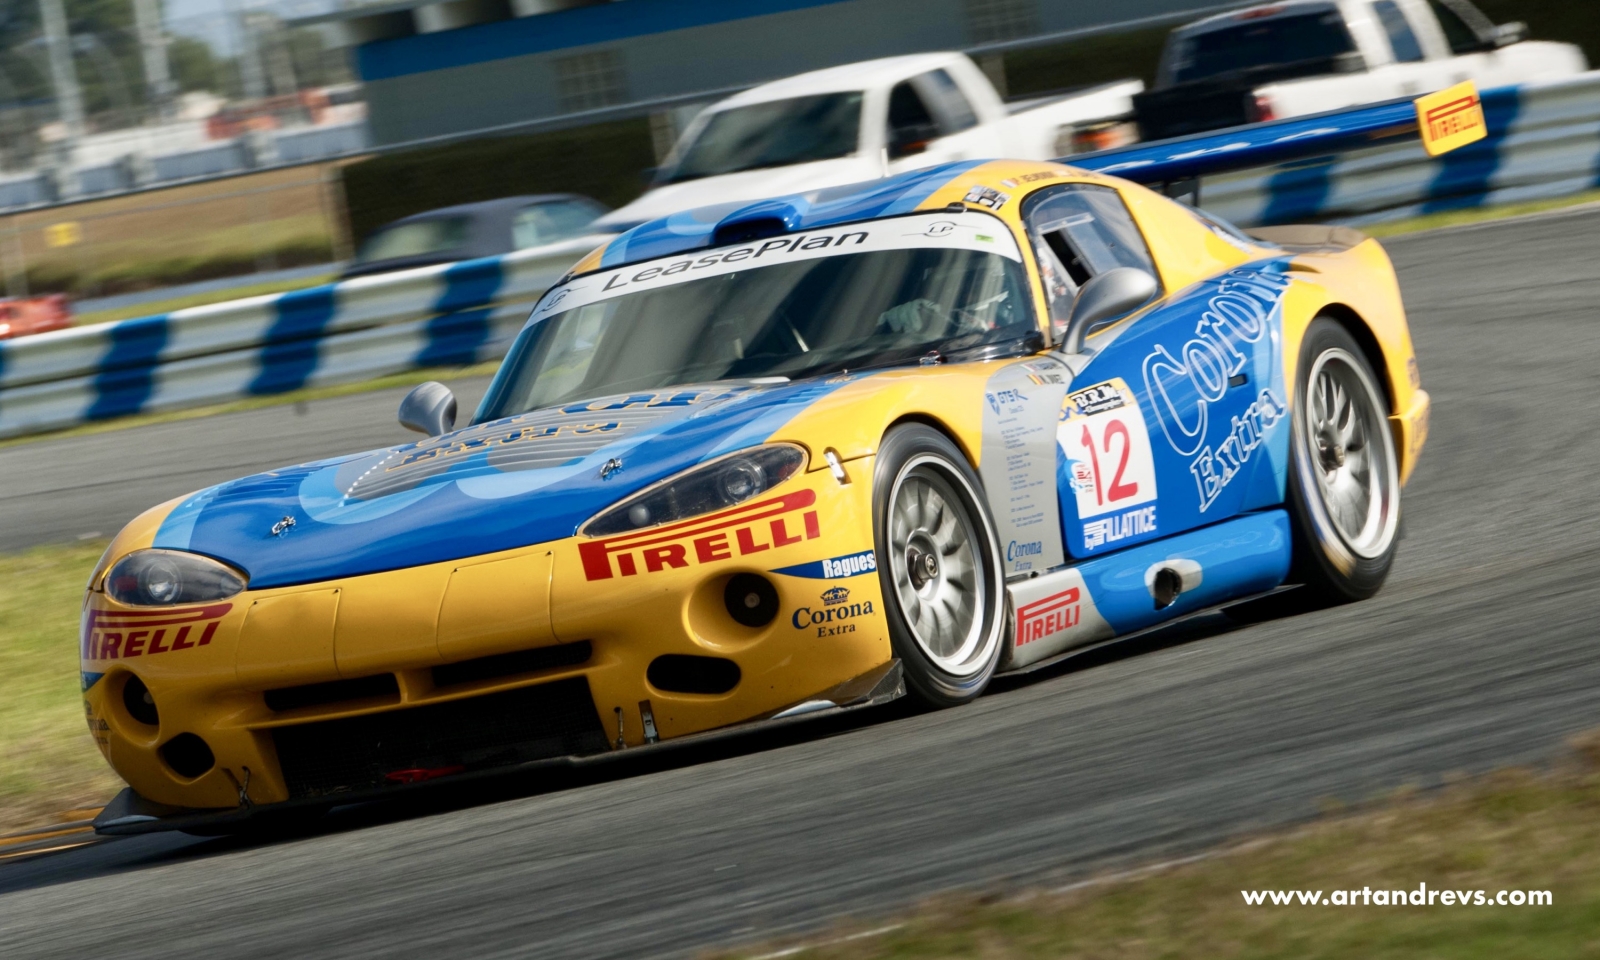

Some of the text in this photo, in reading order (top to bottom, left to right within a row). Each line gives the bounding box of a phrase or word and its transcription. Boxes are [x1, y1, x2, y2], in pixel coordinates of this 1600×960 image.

[1426, 95, 1480, 142] PIRELLI
[602, 231, 870, 292] LeasePlan
[1081, 419, 1139, 506] 12
[1190, 388, 1287, 513] Extra
[577, 488, 821, 581] PIRELLI
[1007, 540, 1042, 562] Corona
[822, 553, 876, 578] Ragues
[83, 603, 233, 660] PIRELLI
[792, 600, 873, 630] Corona
[817, 624, 856, 638] Extra
[1016, 587, 1080, 647] PIRELLI
